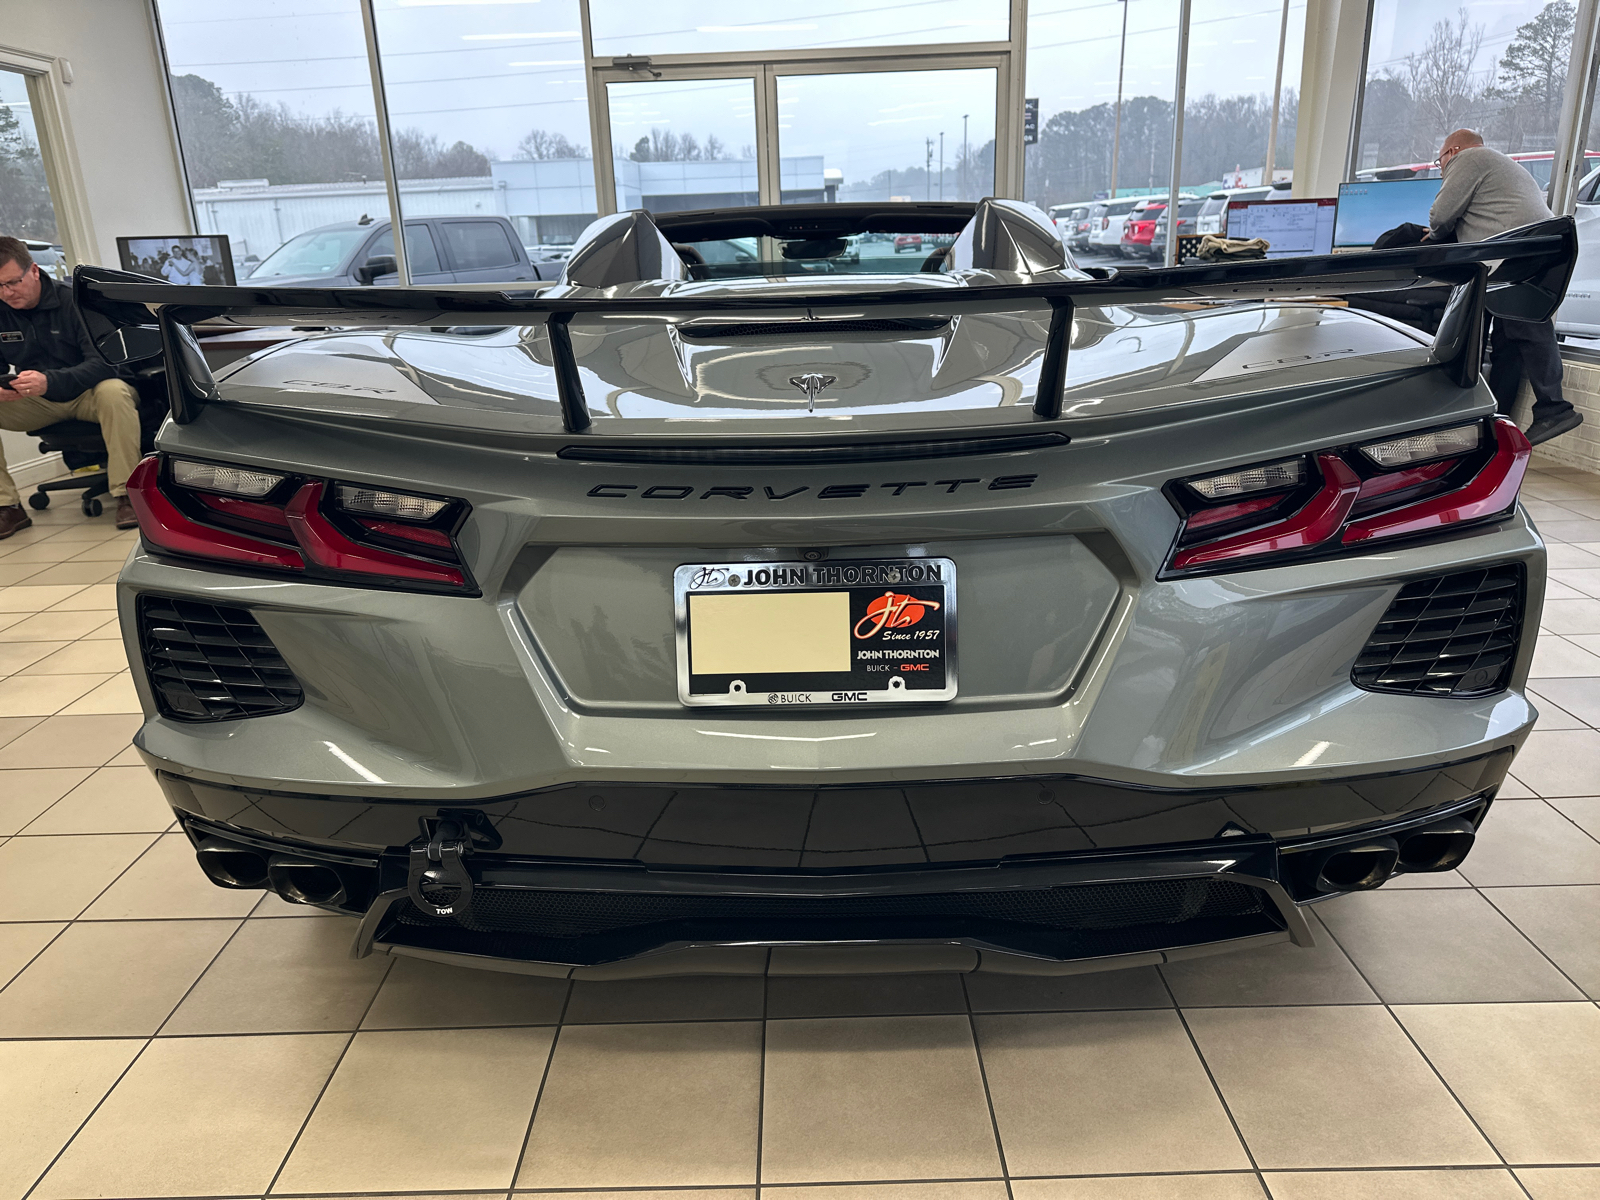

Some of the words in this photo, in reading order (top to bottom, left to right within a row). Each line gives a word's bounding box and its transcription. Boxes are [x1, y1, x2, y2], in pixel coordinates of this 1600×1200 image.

[586, 473, 1039, 500] CORVETTE
[743, 568, 806, 586] JOHN
[813, 565, 943, 585] THORNTON
[881, 631, 912, 641] Since
[913, 630, 941, 640] 1957
[857, 650, 882, 660] JOHN
[883, 649, 940, 660] THORNTON
[866, 664, 890, 672] BUICK
[900, 663, 930, 672] GMC
[780, 693, 812, 703] BUICK
[831, 692, 868, 702] GMC
[436, 907, 453, 915] TOW
